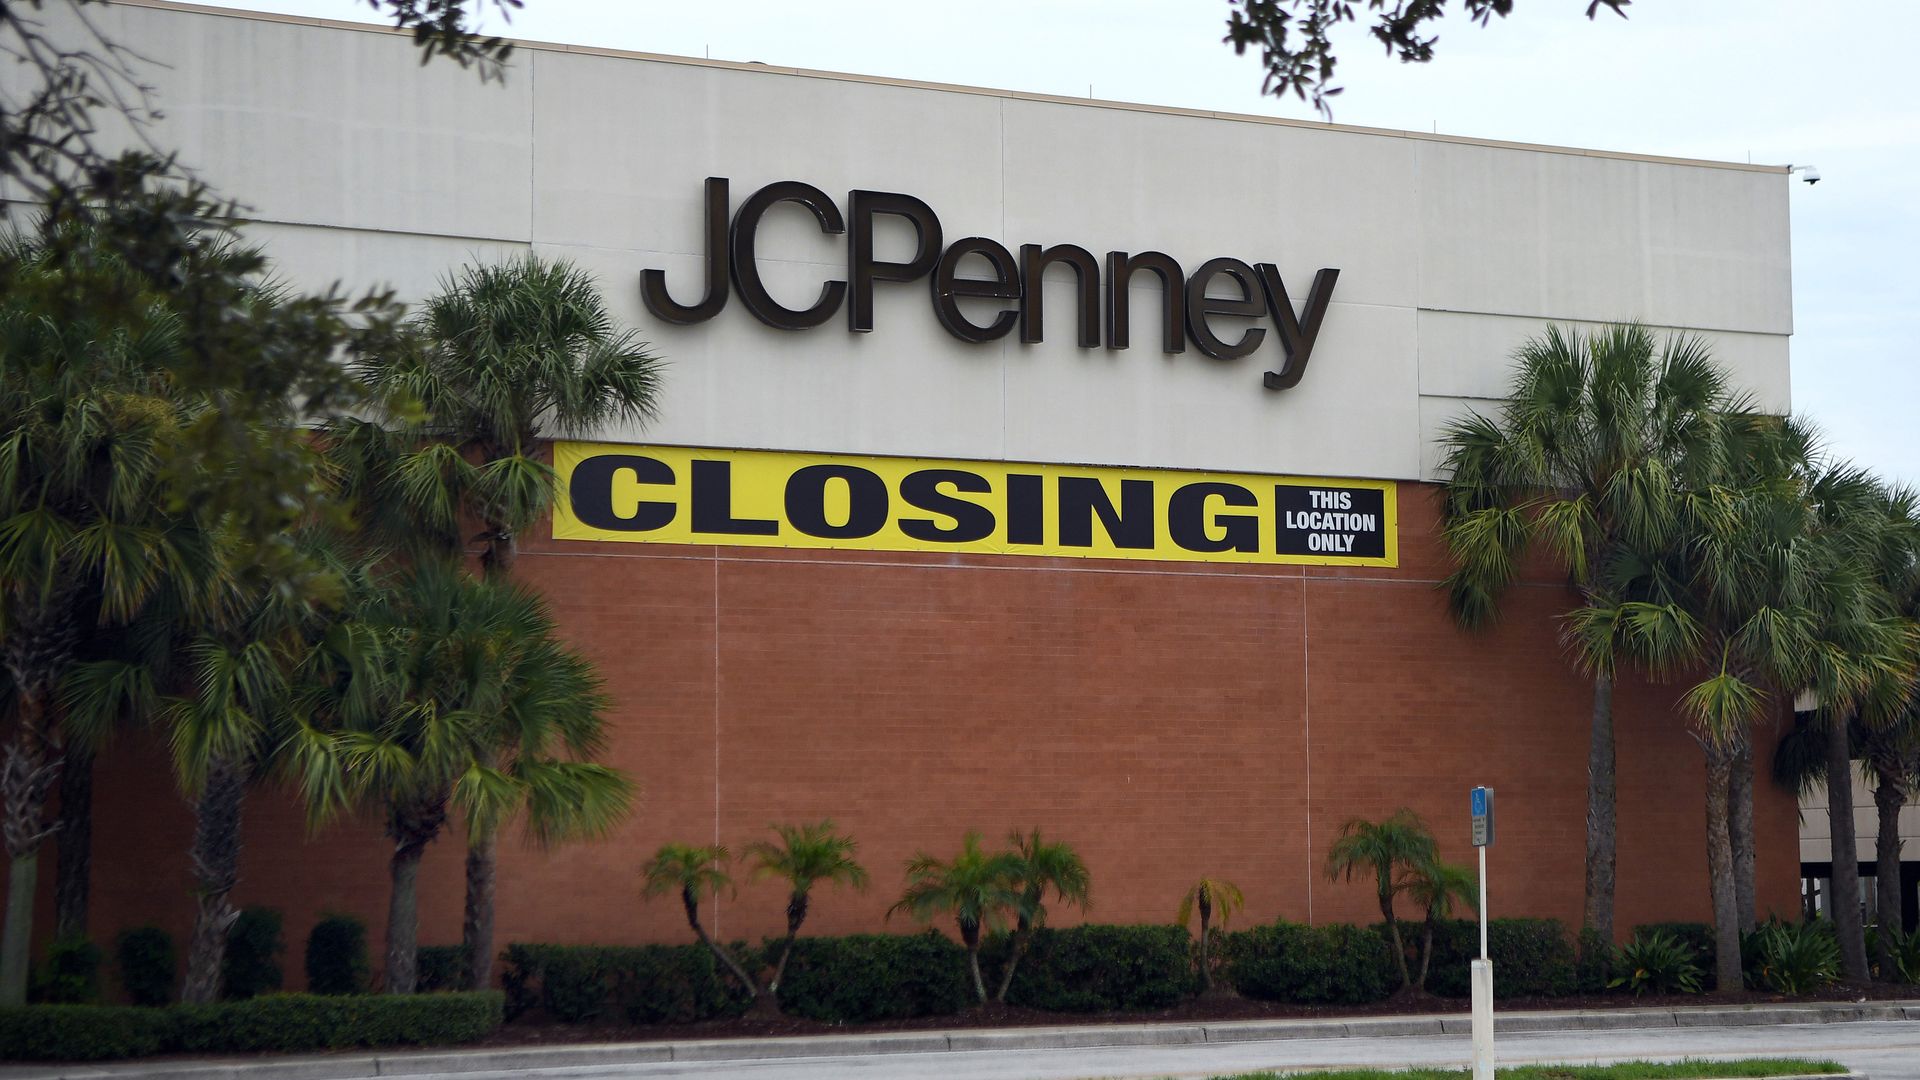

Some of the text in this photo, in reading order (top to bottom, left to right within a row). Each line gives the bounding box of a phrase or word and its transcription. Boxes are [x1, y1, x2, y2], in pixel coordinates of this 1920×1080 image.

[640, 177, 1341, 390] JCPenney
[570, 454, 1259, 553] CLOSING
[1309, 490, 1352, 510] THIS
[1286, 511, 1376, 532] LOCATION
[1308, 533, 1355, 552] ONLY
